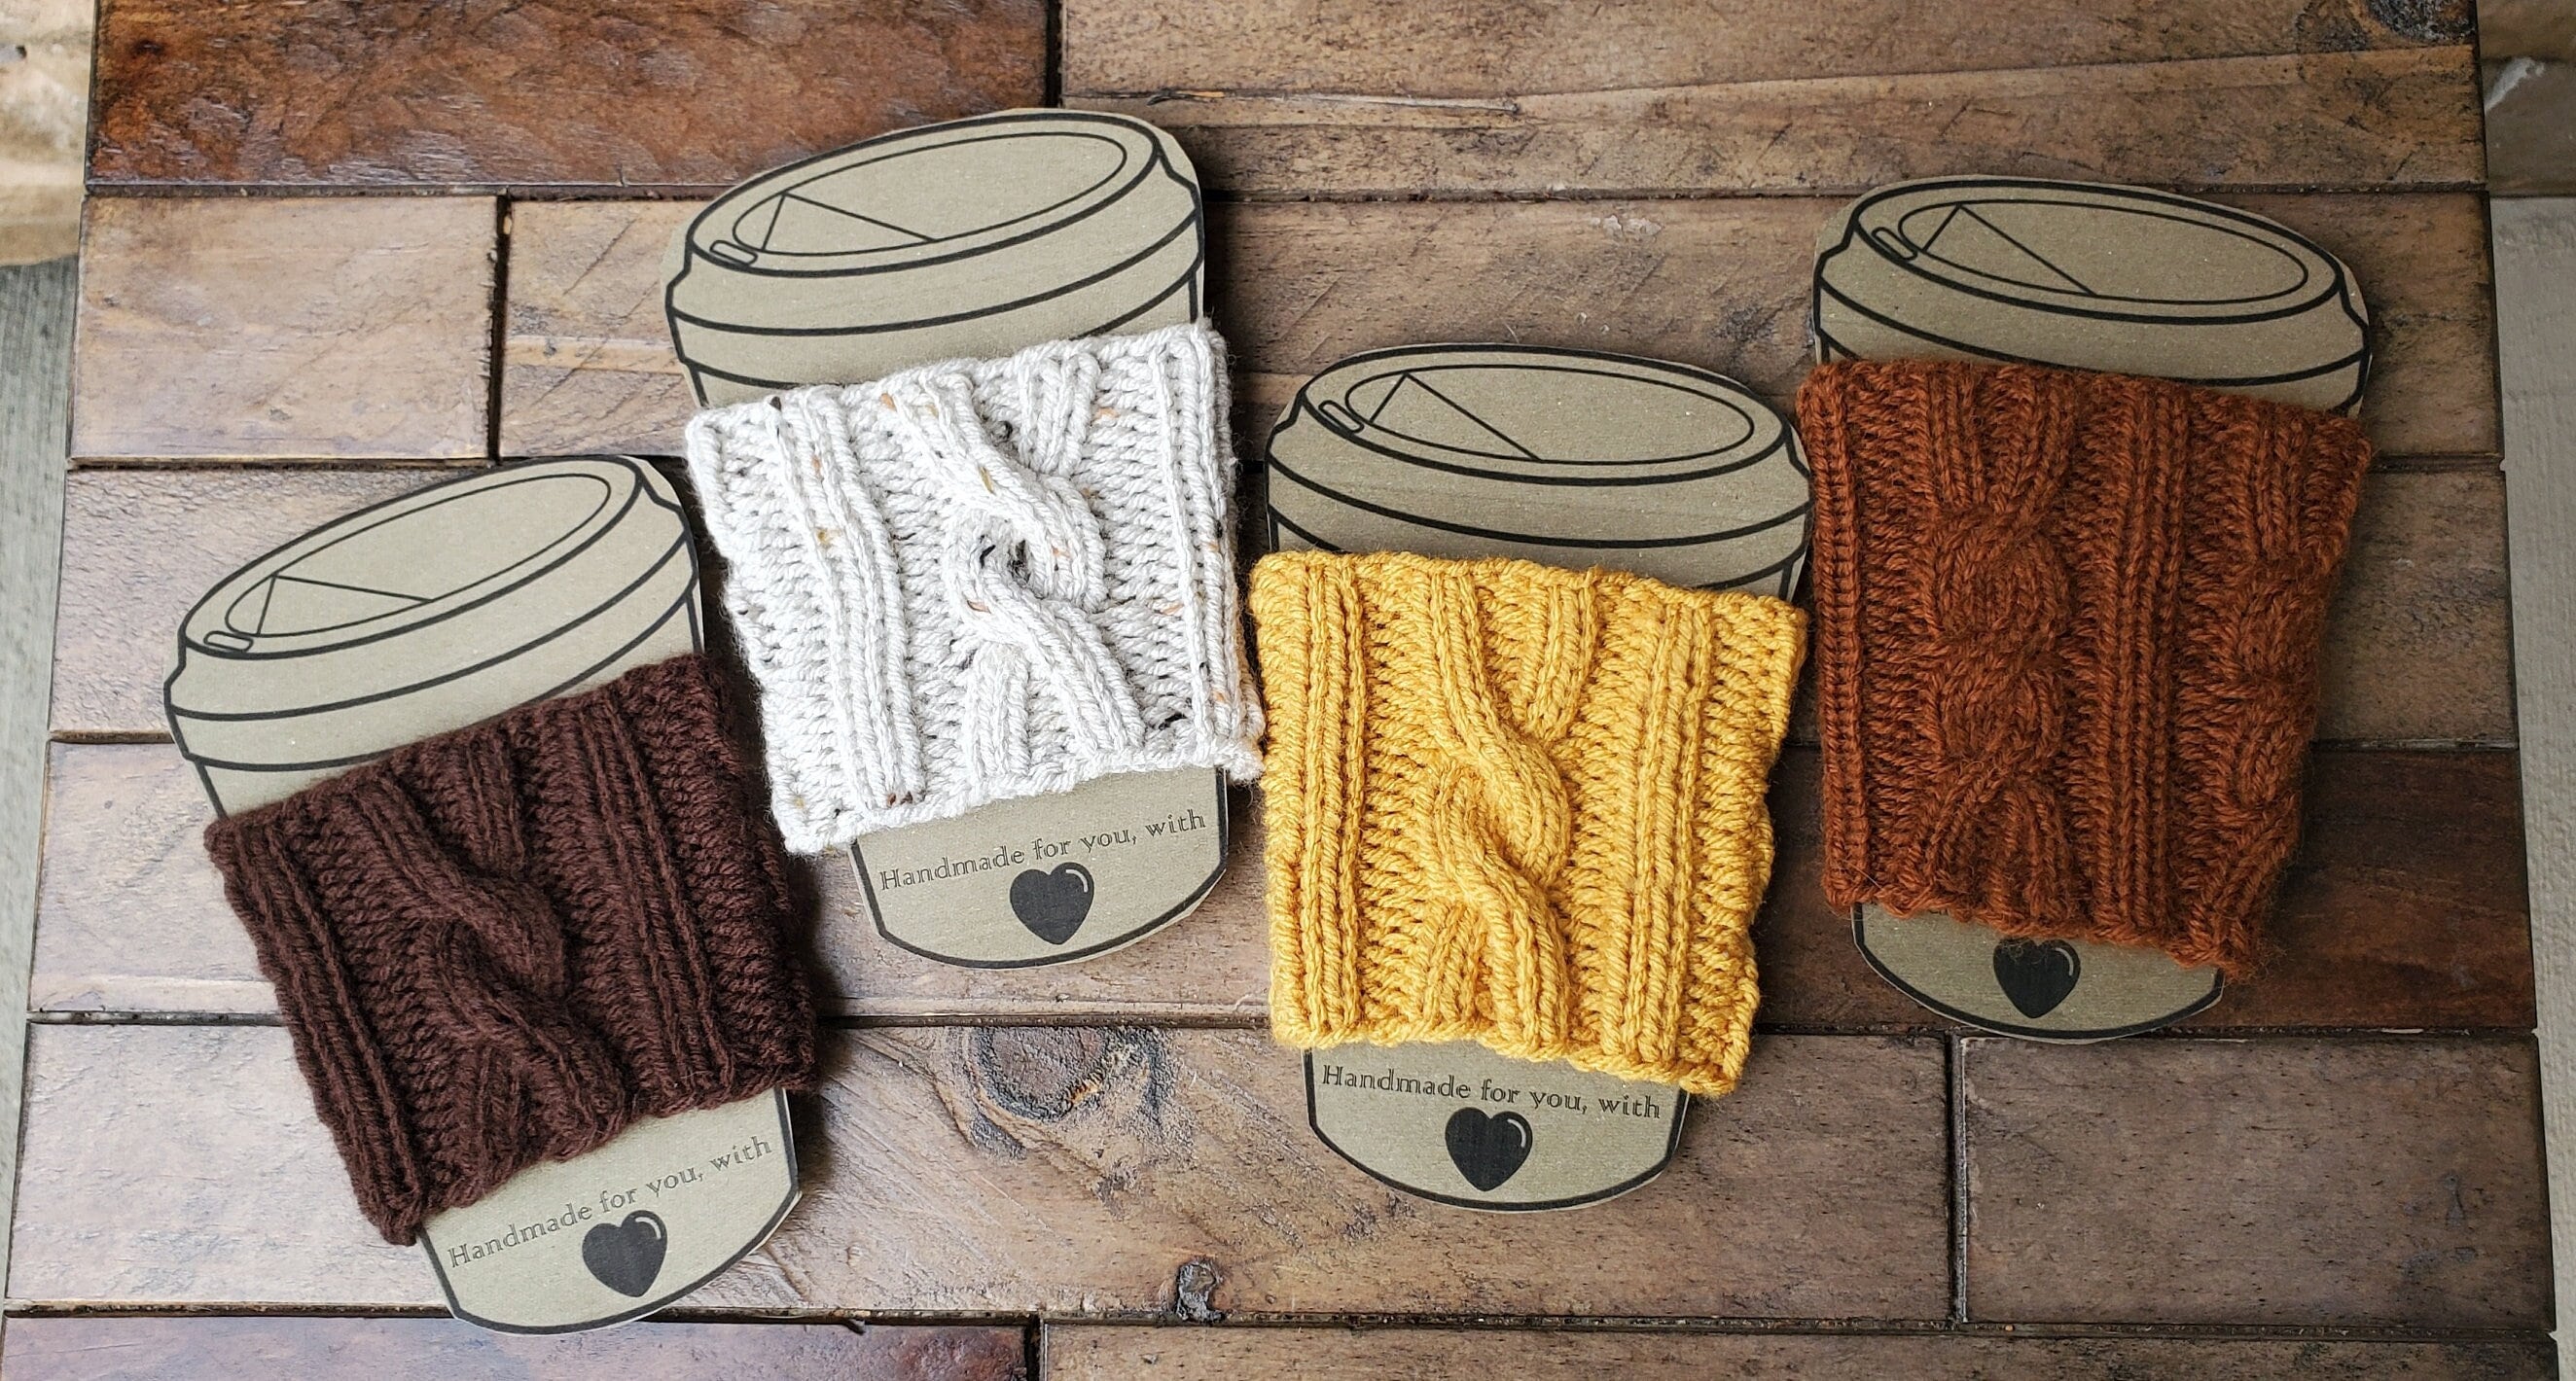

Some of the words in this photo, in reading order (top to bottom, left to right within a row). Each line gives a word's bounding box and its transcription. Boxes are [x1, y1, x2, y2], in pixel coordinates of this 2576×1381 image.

[879, 846, 1025, 891] Handmade
[1033, 838, 1071, 861] for
[1079, 829, 1137, 853] you,
[1145, 809, 1206, 837] with
[1322, 1065, 1471, 1099] Handmade
[1481, 1079, 1521, 1103] for
[1529, 1090, 1588, 1115] you,
[1598, 1094, 1661, 1119] with
[447, 1204, 592, 1268] Handmade
[599, 1188, 637, 1215] for
[645, 1166, 703, 1198] you,
[709, 1136, 772, 1172] with
